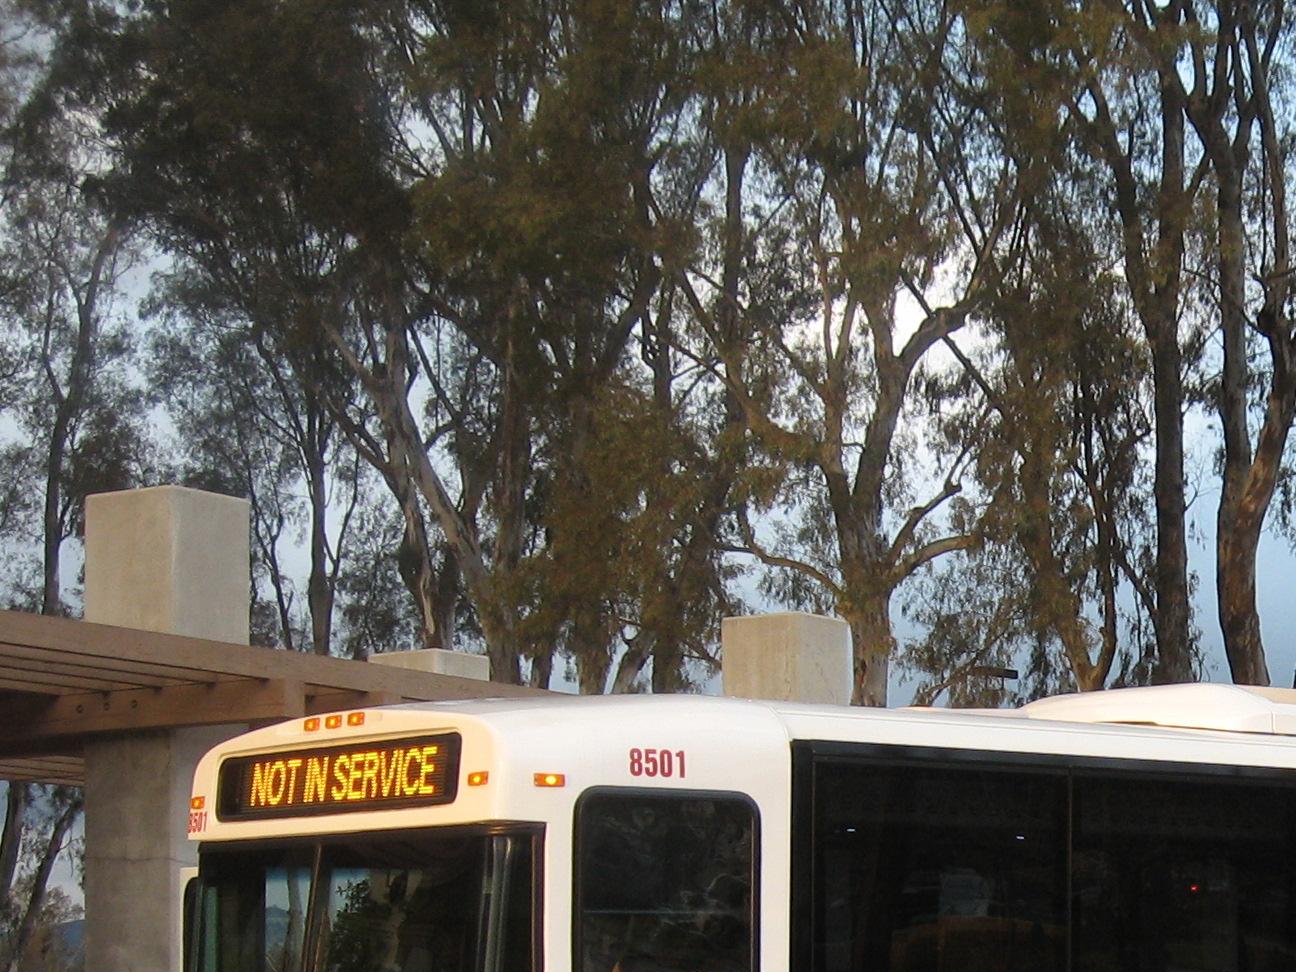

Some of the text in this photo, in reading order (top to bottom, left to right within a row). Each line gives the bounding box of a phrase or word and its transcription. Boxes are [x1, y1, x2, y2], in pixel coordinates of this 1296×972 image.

[250, 746, 437, 806] NOT IN SERVICE
[629, 748, 686, 778] 8501
